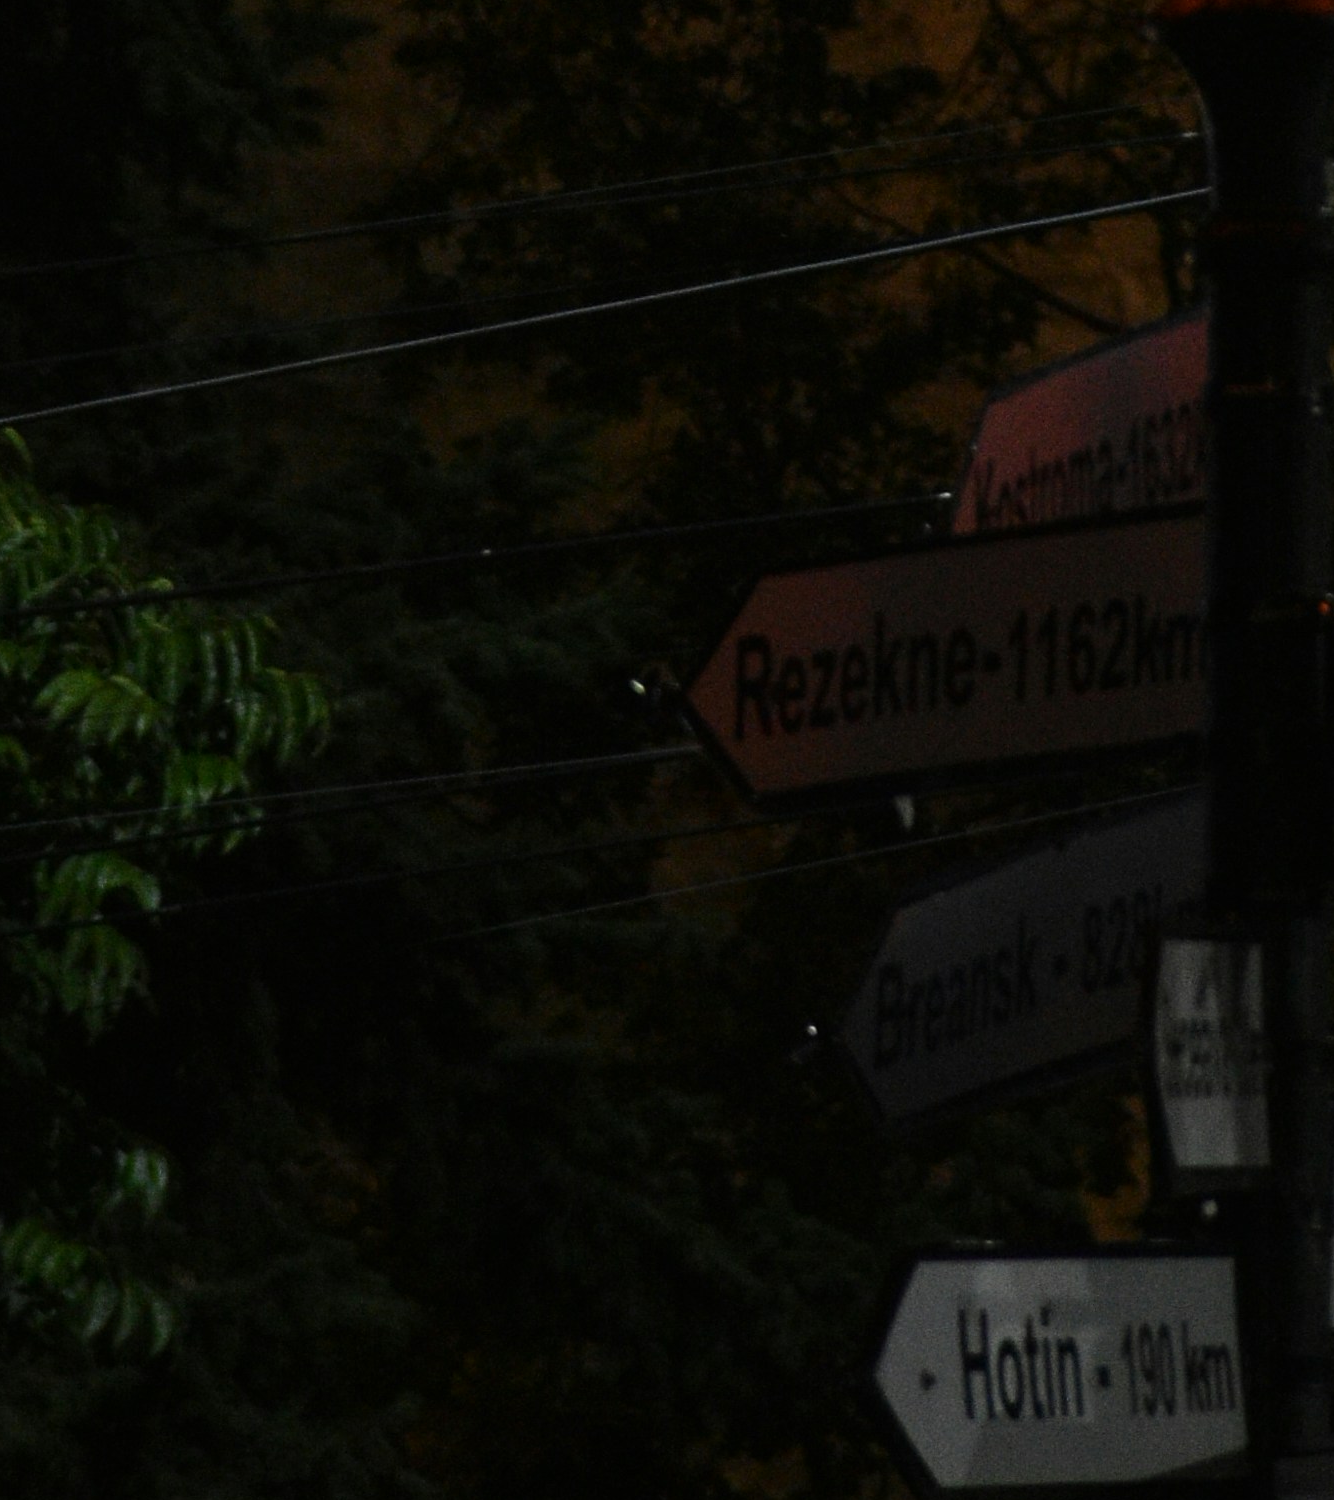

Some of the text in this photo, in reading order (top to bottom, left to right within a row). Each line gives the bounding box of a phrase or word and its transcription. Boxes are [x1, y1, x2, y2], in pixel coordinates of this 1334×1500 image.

[733, 593, 1208, 739] Rezekne-1162km
[957, 1306, 1086, 1421] Hotin
[1120, 1323, 1179, 1418] 190
[1184, 1325, 1239, 1414] km
